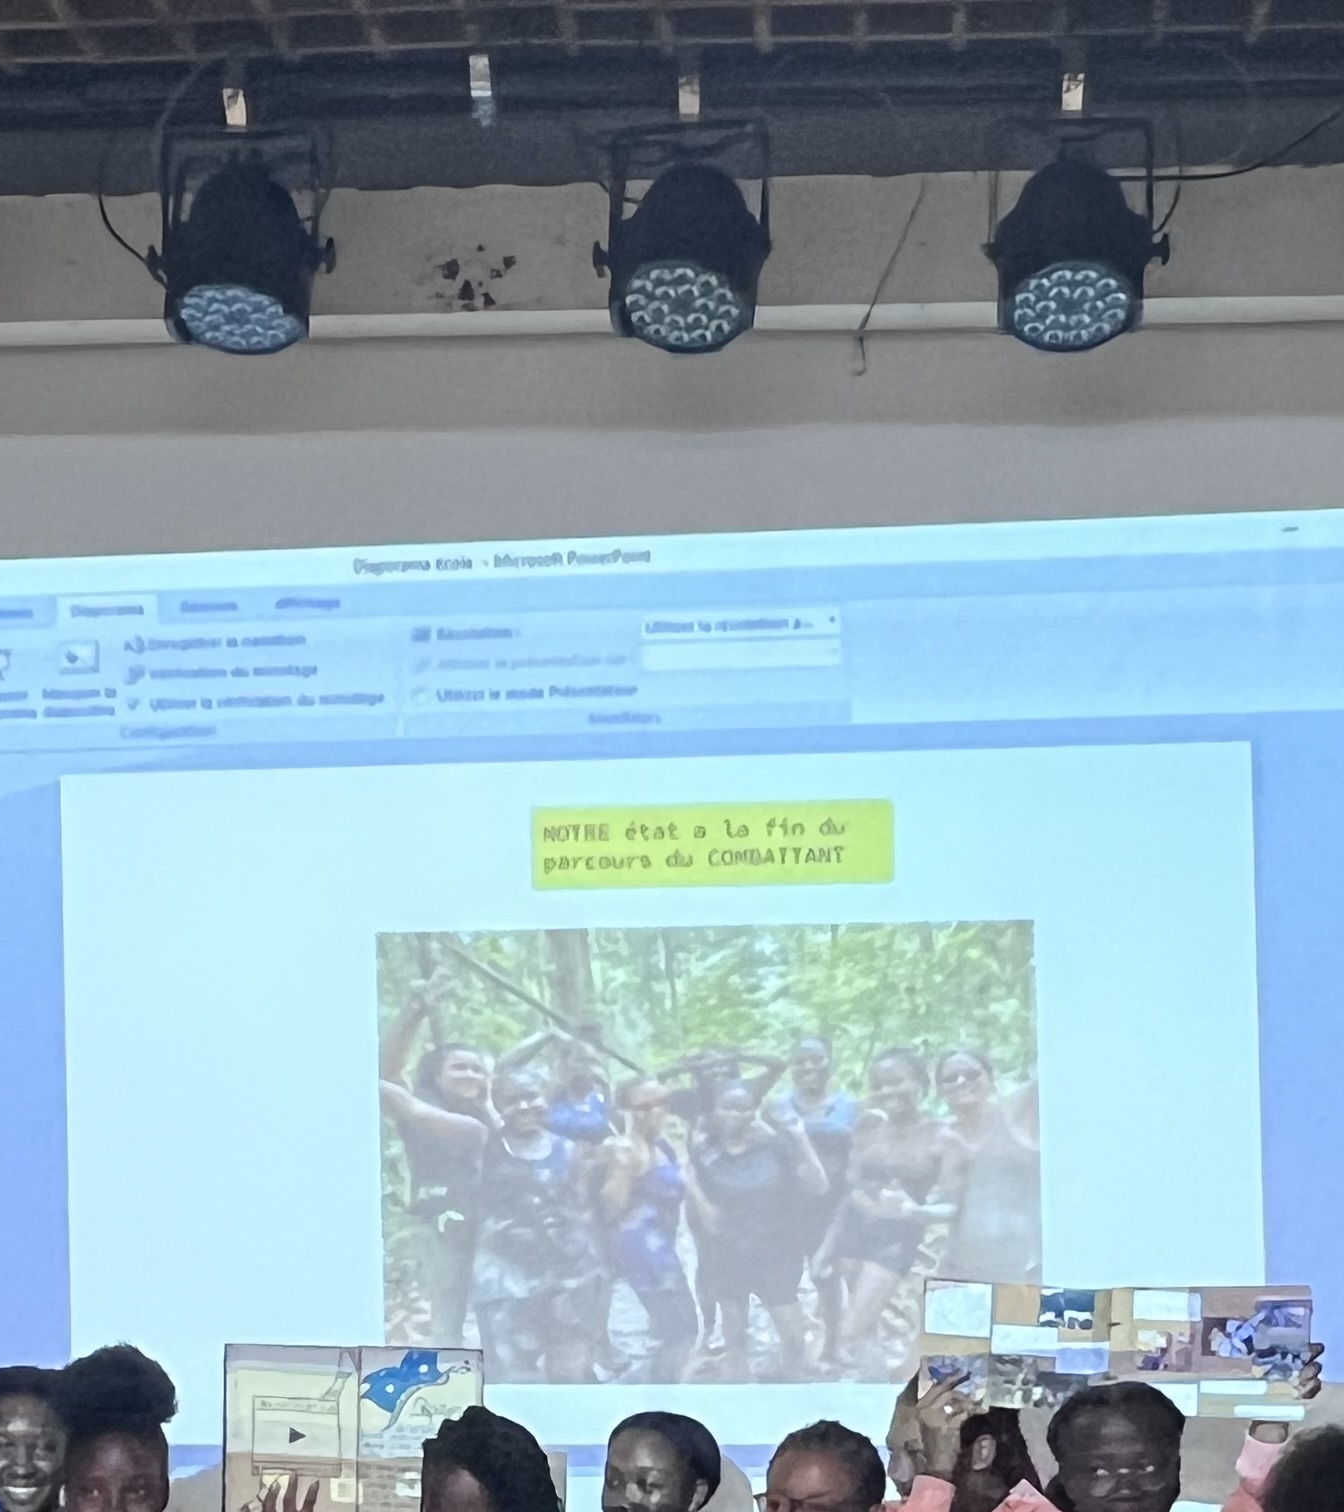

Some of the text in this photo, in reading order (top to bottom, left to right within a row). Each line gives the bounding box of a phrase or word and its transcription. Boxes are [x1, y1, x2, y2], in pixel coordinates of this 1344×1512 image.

[543, 822, 610, 843] NOTRE
[723, 818, 750, 839] la
[766, 816, 806, 837] fin
[818, 815, 847, 836] du
[543, 844, 846, 875] parcours du COMBATTANT
